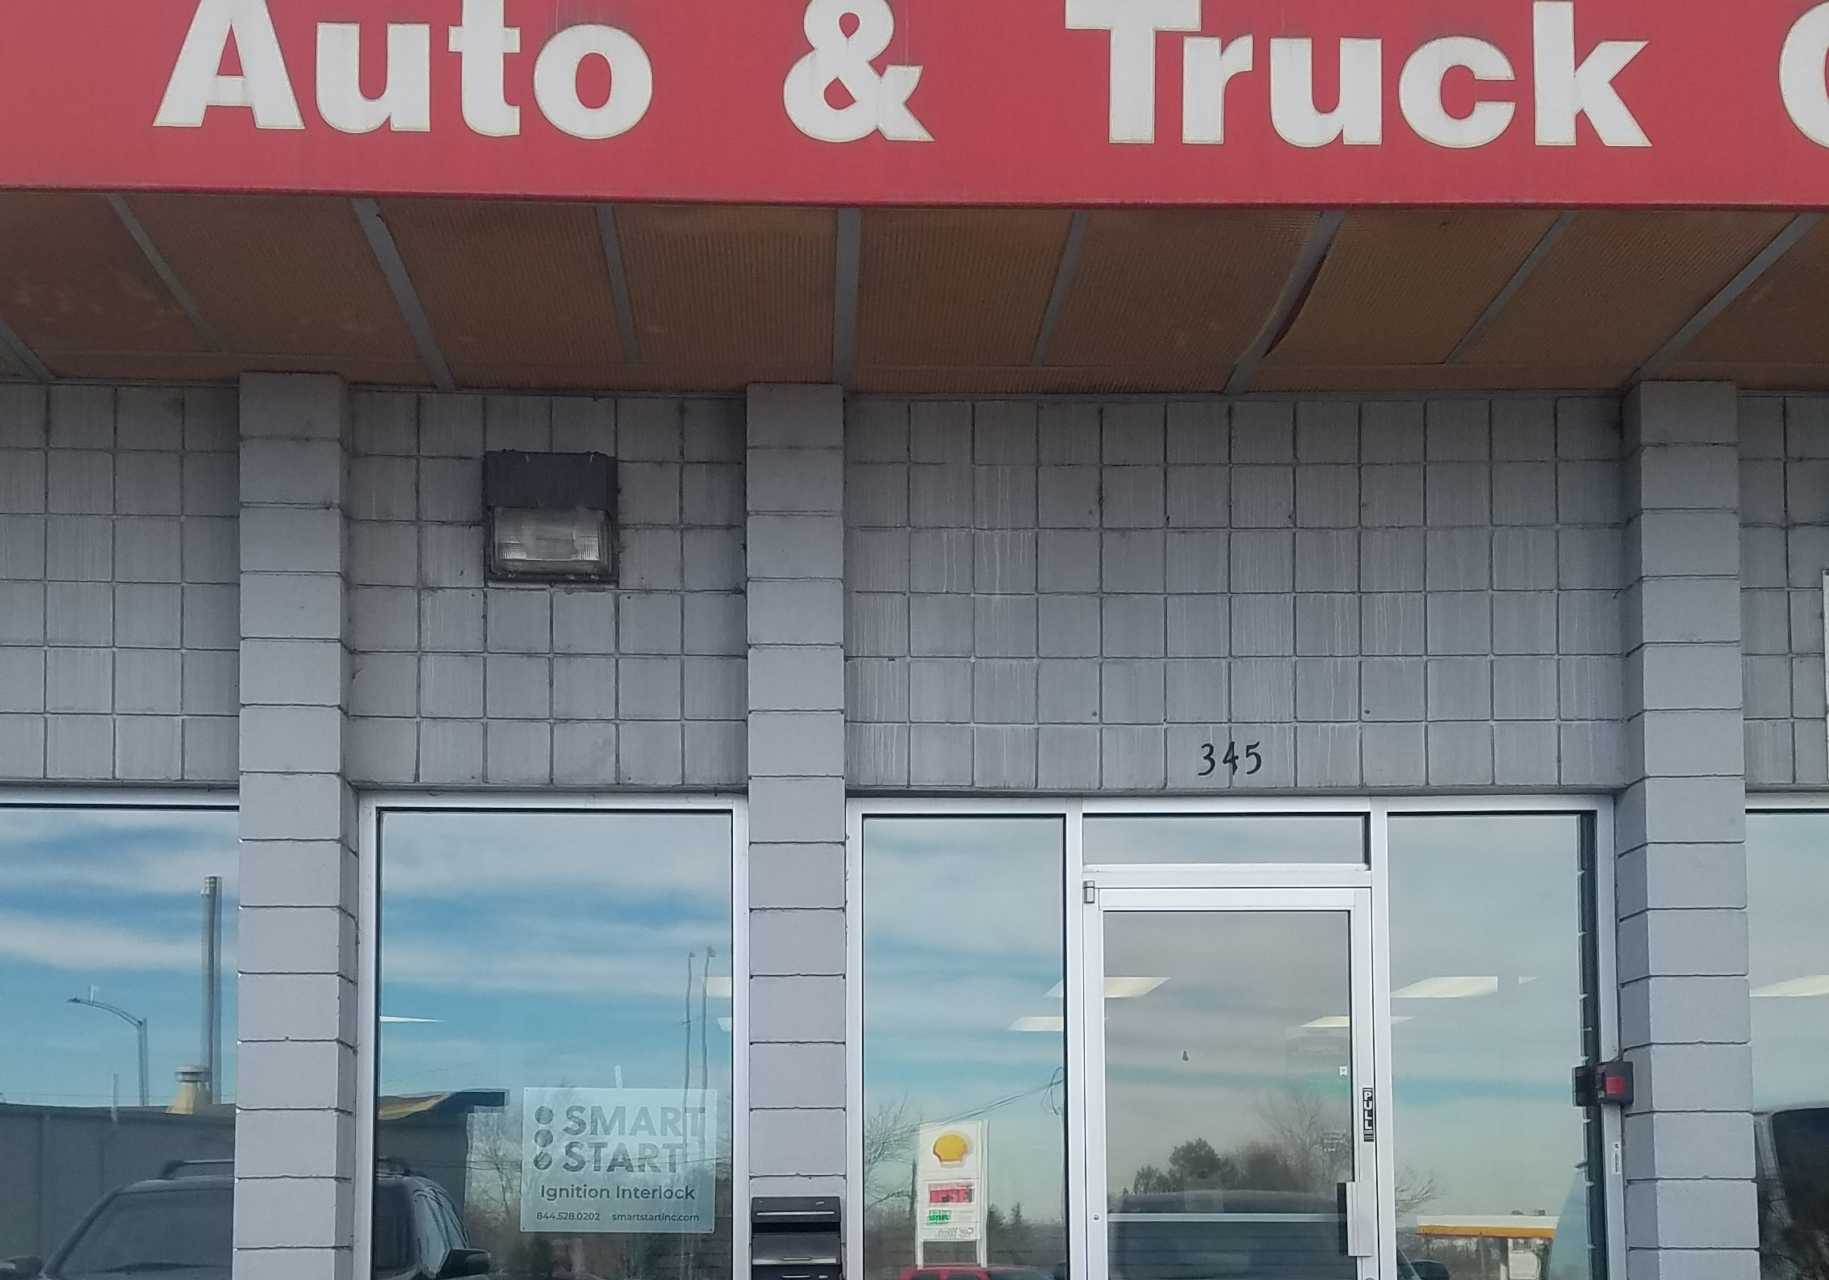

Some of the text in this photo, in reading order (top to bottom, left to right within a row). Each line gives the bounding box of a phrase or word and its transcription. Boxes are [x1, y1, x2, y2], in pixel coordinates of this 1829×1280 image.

[152, 0, 654, 140] Auto
[783, 0, 937, 143] &
[1065, 0, 1653, 148] Truck
[1197, 741, 1262, 776] 345
[562, 1105, 706, 1137] SMART
[1363, 1091, 1373, 1130] PULL
[562, 1141, 685, 1174] START
[541, 1184, 696, 1202] Ignition Interlock
[536, 1211, 700, 1223] 844.528.0202 smartstartinc.com
